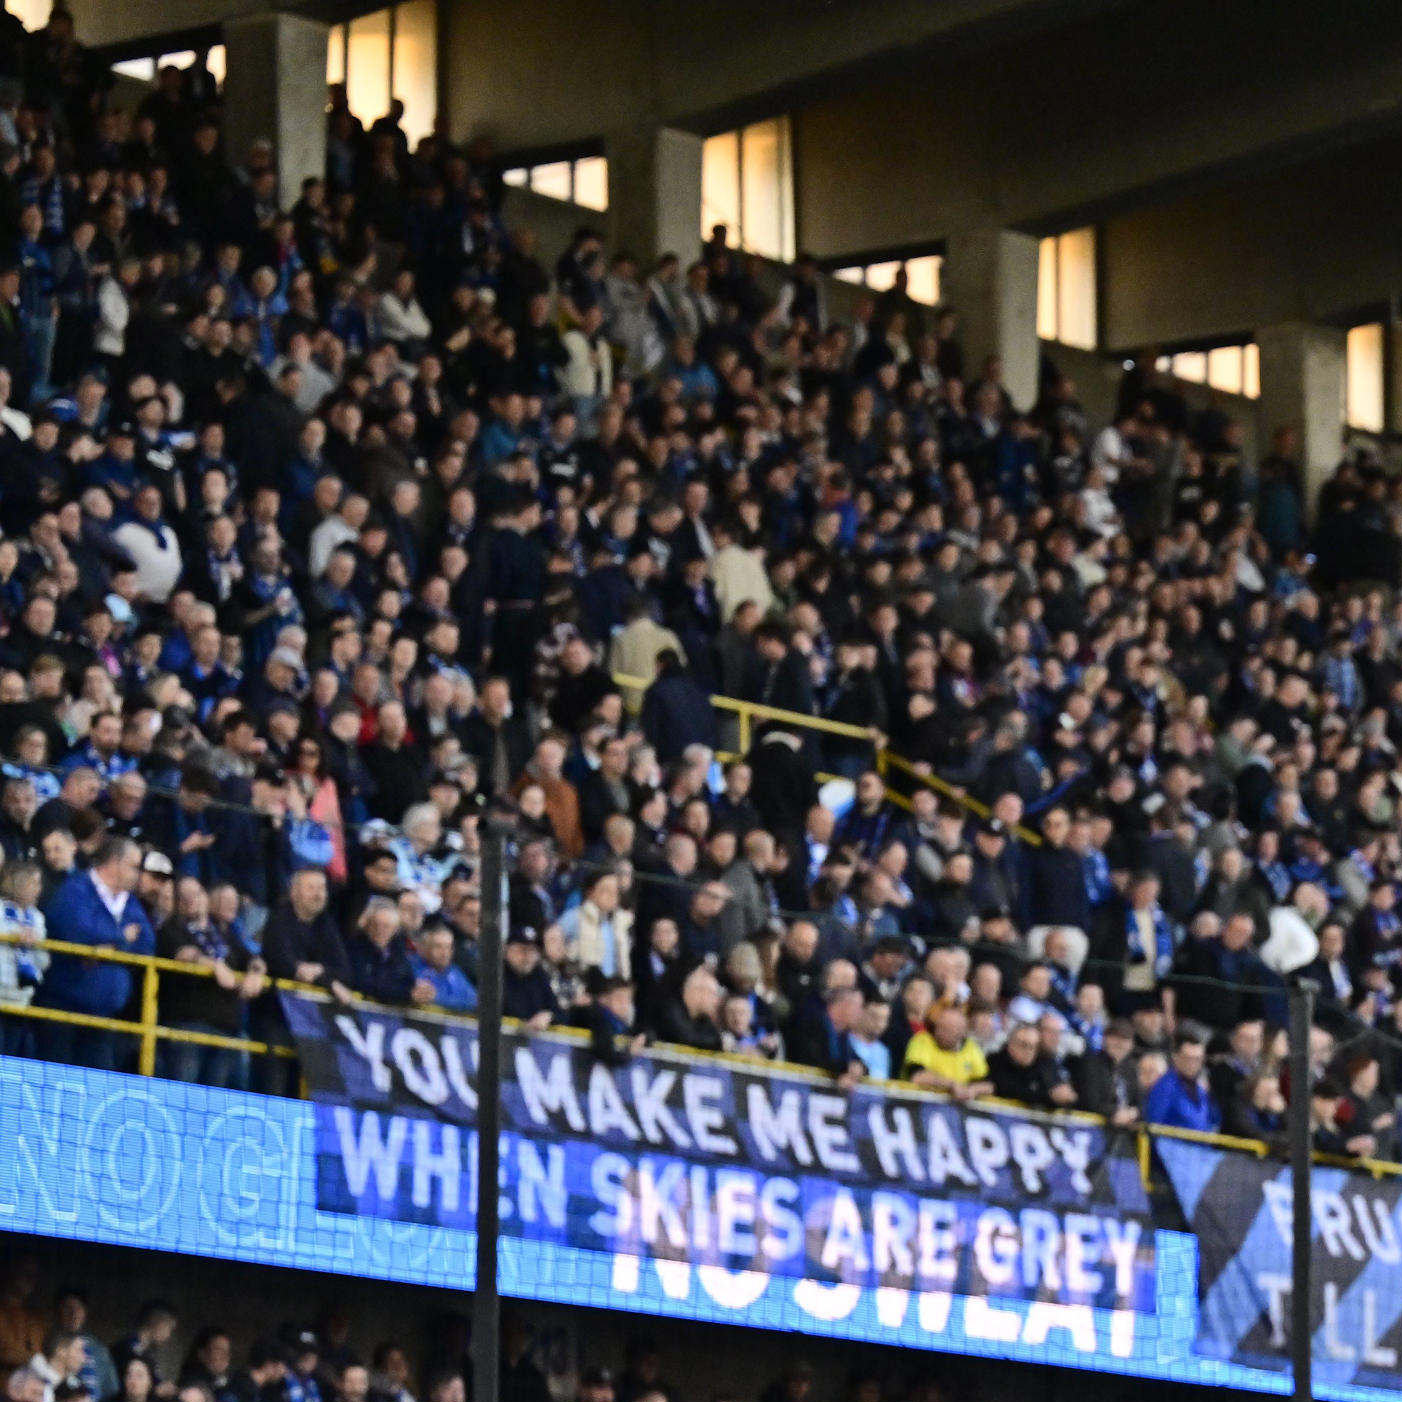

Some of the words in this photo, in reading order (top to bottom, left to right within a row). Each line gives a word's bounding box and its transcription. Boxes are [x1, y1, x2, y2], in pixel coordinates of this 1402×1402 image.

[334, 1014, 480, 1111] YOU
[514, 1047, 738, 1157] MAKE
[748, 1083, 863, 1177] ME
[867, 1104, 1094, 1196] HAPPY
[589, 1151, 805, 1262] SKIES
[821, 1185, 959, 1281] ARE
[973, 1206, 1143, 1297] GREY
[1257, 1272, 1398, 1368] TLL
